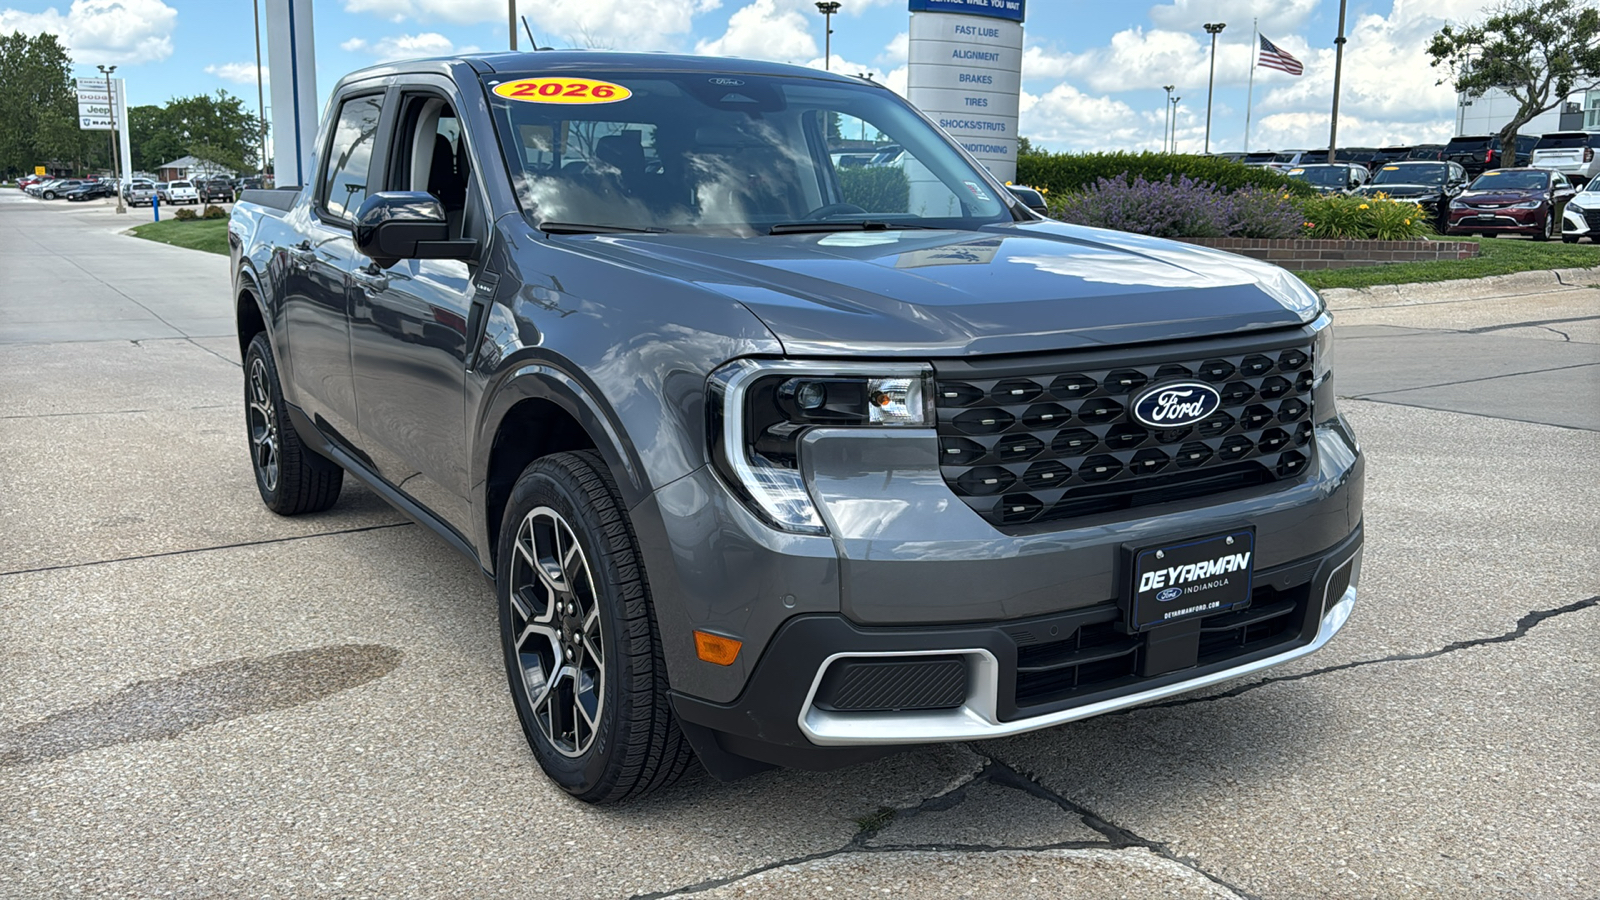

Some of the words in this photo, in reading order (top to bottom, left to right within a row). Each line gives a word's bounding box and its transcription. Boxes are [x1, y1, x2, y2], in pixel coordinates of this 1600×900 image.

[991, 0, 1004, 8] YOU
[1006, 2, 1020, 10] WAIT
[955, 25, 976, 36] FAST
[978, 27, 999, 38] LUBE
[952, 50, 1000, 62] ALIGNMENT
[959, 74, 993, 84] BRAKES
[510, 83, 616, 98] 2026
[964, 97, 988, 107] TIRES
[87, 105, 110, 114] Jeep
[940, 119, 1006, 132] SHOCKS/STRUTS
[1152, 390, 1206, 421] Ford
[1139, 552, 1251, 593] DEYARMAN
[1184, 578, 1229, 594] INDIANOLA
[1164, 601, 1220, 619] DEYARMANFORD.COM
